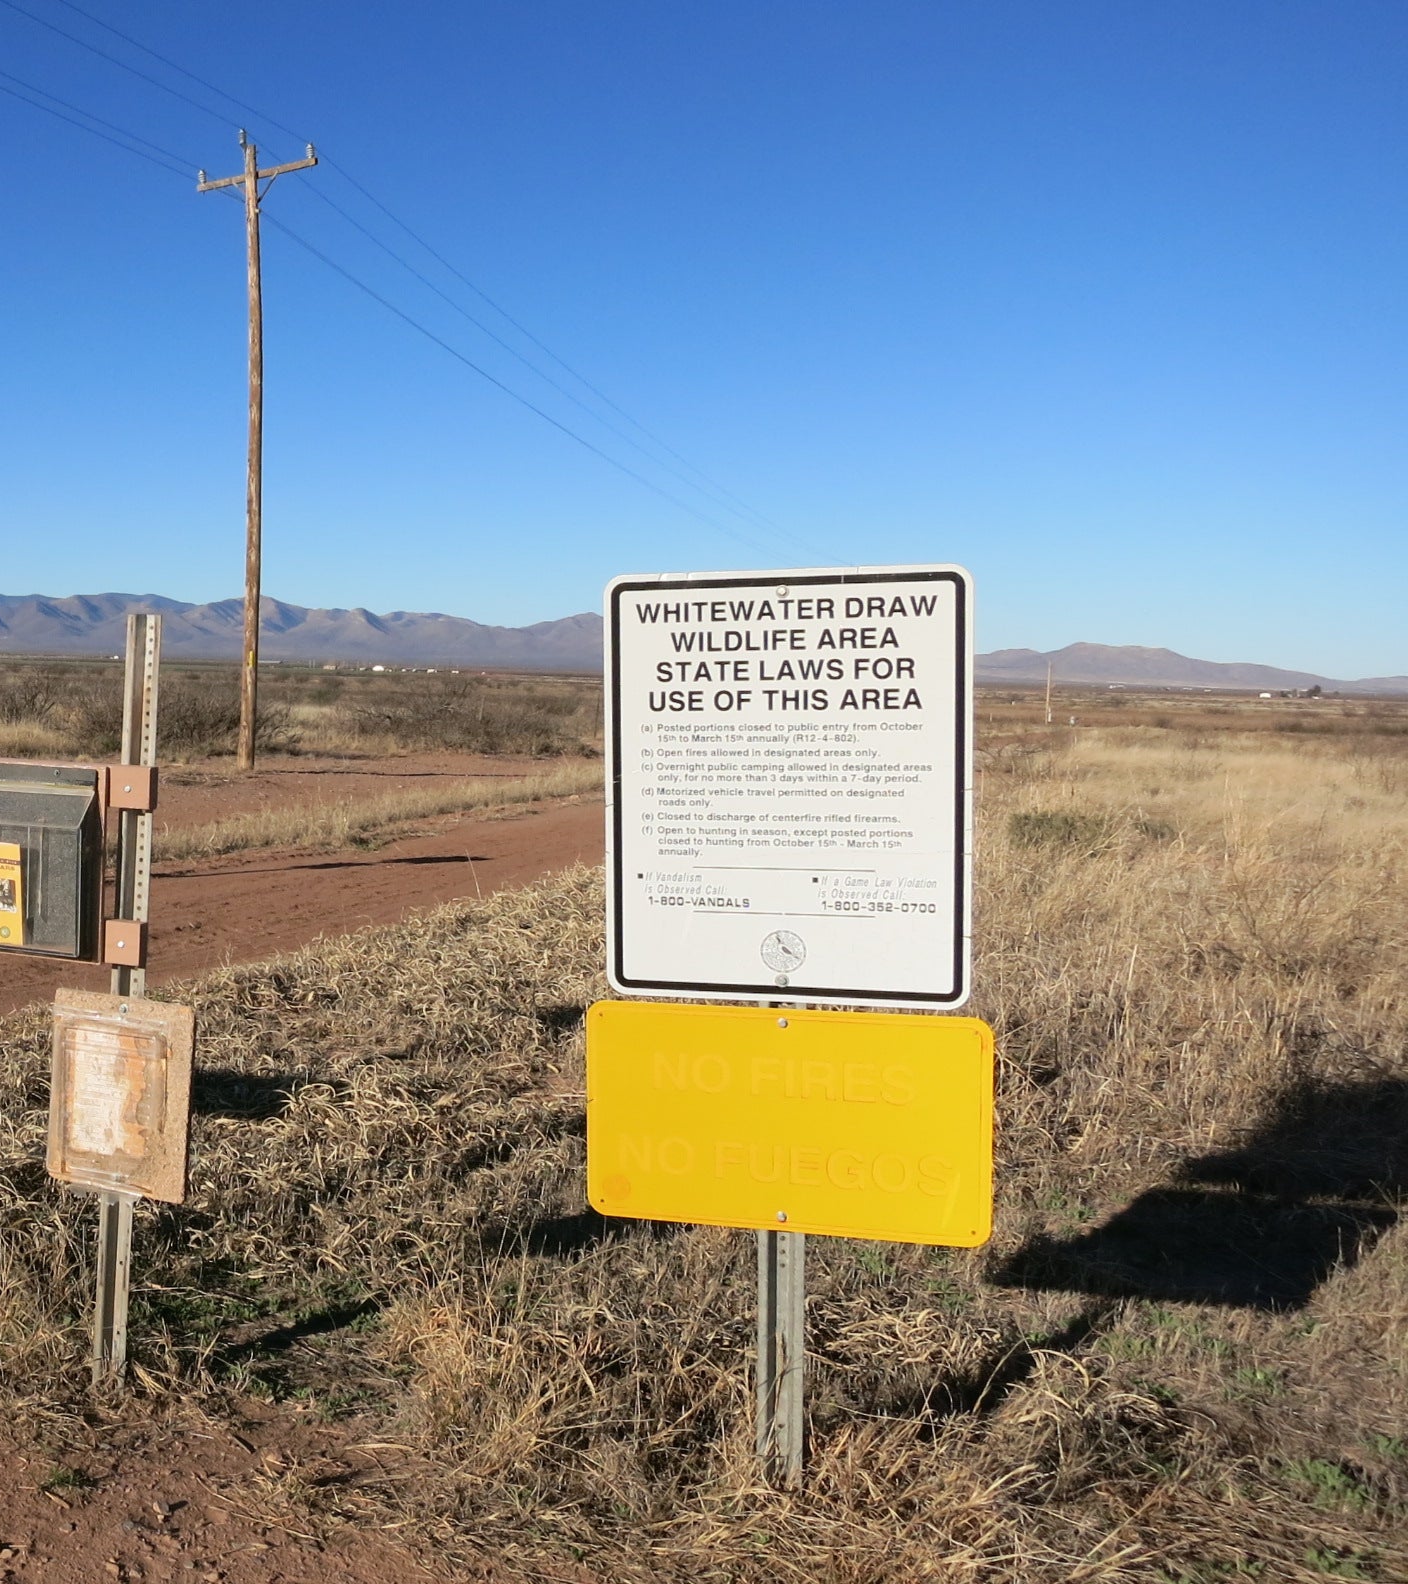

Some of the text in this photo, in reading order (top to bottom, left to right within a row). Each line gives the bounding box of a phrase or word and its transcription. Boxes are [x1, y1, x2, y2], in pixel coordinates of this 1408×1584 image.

[636, 595, 938, 624] WHITEWATER DRAW
[670, 627, 899, 652] WILDLIFE AREA
[656, 658, 915, 683] STATE LAWS FOR
[649, 688, 923, 713] USE OF THIS AREA
[641, 722, 923, 734] (a) Posted portions closed to public entry from October
[746, 735, 789, 744] annually
[793, 734, 860, 744] (R12-4-802).
[641, 749, 654, 758] (b)
[657, 749, 683, 758] Open
[686, 748, 708, 757] fires
[710, 748, 749, 757] allowed
[752, 748, 761, 757] in
[764, 749, 820, 758] designated
[855, 748, 881, 759] only.
[641, 762, 932, 773] (c) Overnight public camping allowed in designated areas
[658, 774, 682, 784] only,
[684, 774, 699, 782] for
[745, 774, 768, 782] than
[770, 774, 776, 782] 3
[780, 774, 803, 784] days
[807, 774, 838, 782] within
[850, 774, 881, 784] 7-day
[884, 774, 922, 784] period.
[642, 788, 654, 797] (d)
[657, 787, 705, 796] Motorized
[708, 788, 743, 796] vehicle
[746, 788, 775, 797] travel
[778, 789, 827, 799] permitted
[846, 789, 904, 799] designated
[658, 798, 713, 808] roads only.
[642, 812, 901, 823] (e) Closed to discharge of centerfire rifled firearms.
[642, 826, 913, 839] (f) Open to hunting in season, except posted portions
[658, 837, 691, 845] closed
[694, 838, 703, 846] to
[706, 838, 744, 847] hunting
[747, 838, 770, 847] from
[773, 838, 814, 847] October
[847, 840, 879, 848] March
[658, 848, 703, 857] annually.
[645, 872, 702, 882] If Vandalism
[821, 875, 828, 885] If
[845, 876, 869, 887] Game
[875, 877, 892, 887] Law
[898, 877, 937, 889] Violation
[644, 883, 652, 894] is
[657, 884, 701, 895] Observed
[817, 888, 826, 899] is
[831, 888, 878, 900] Observed
[648, 896, 750, 908] 1-800-VANDALS
[822, 901, 936, 913] 1-800-352-0700
[652, 1050, 917, 1107] NO FIRES
[616, 1133, 955, 1199] NO FUEGOS
